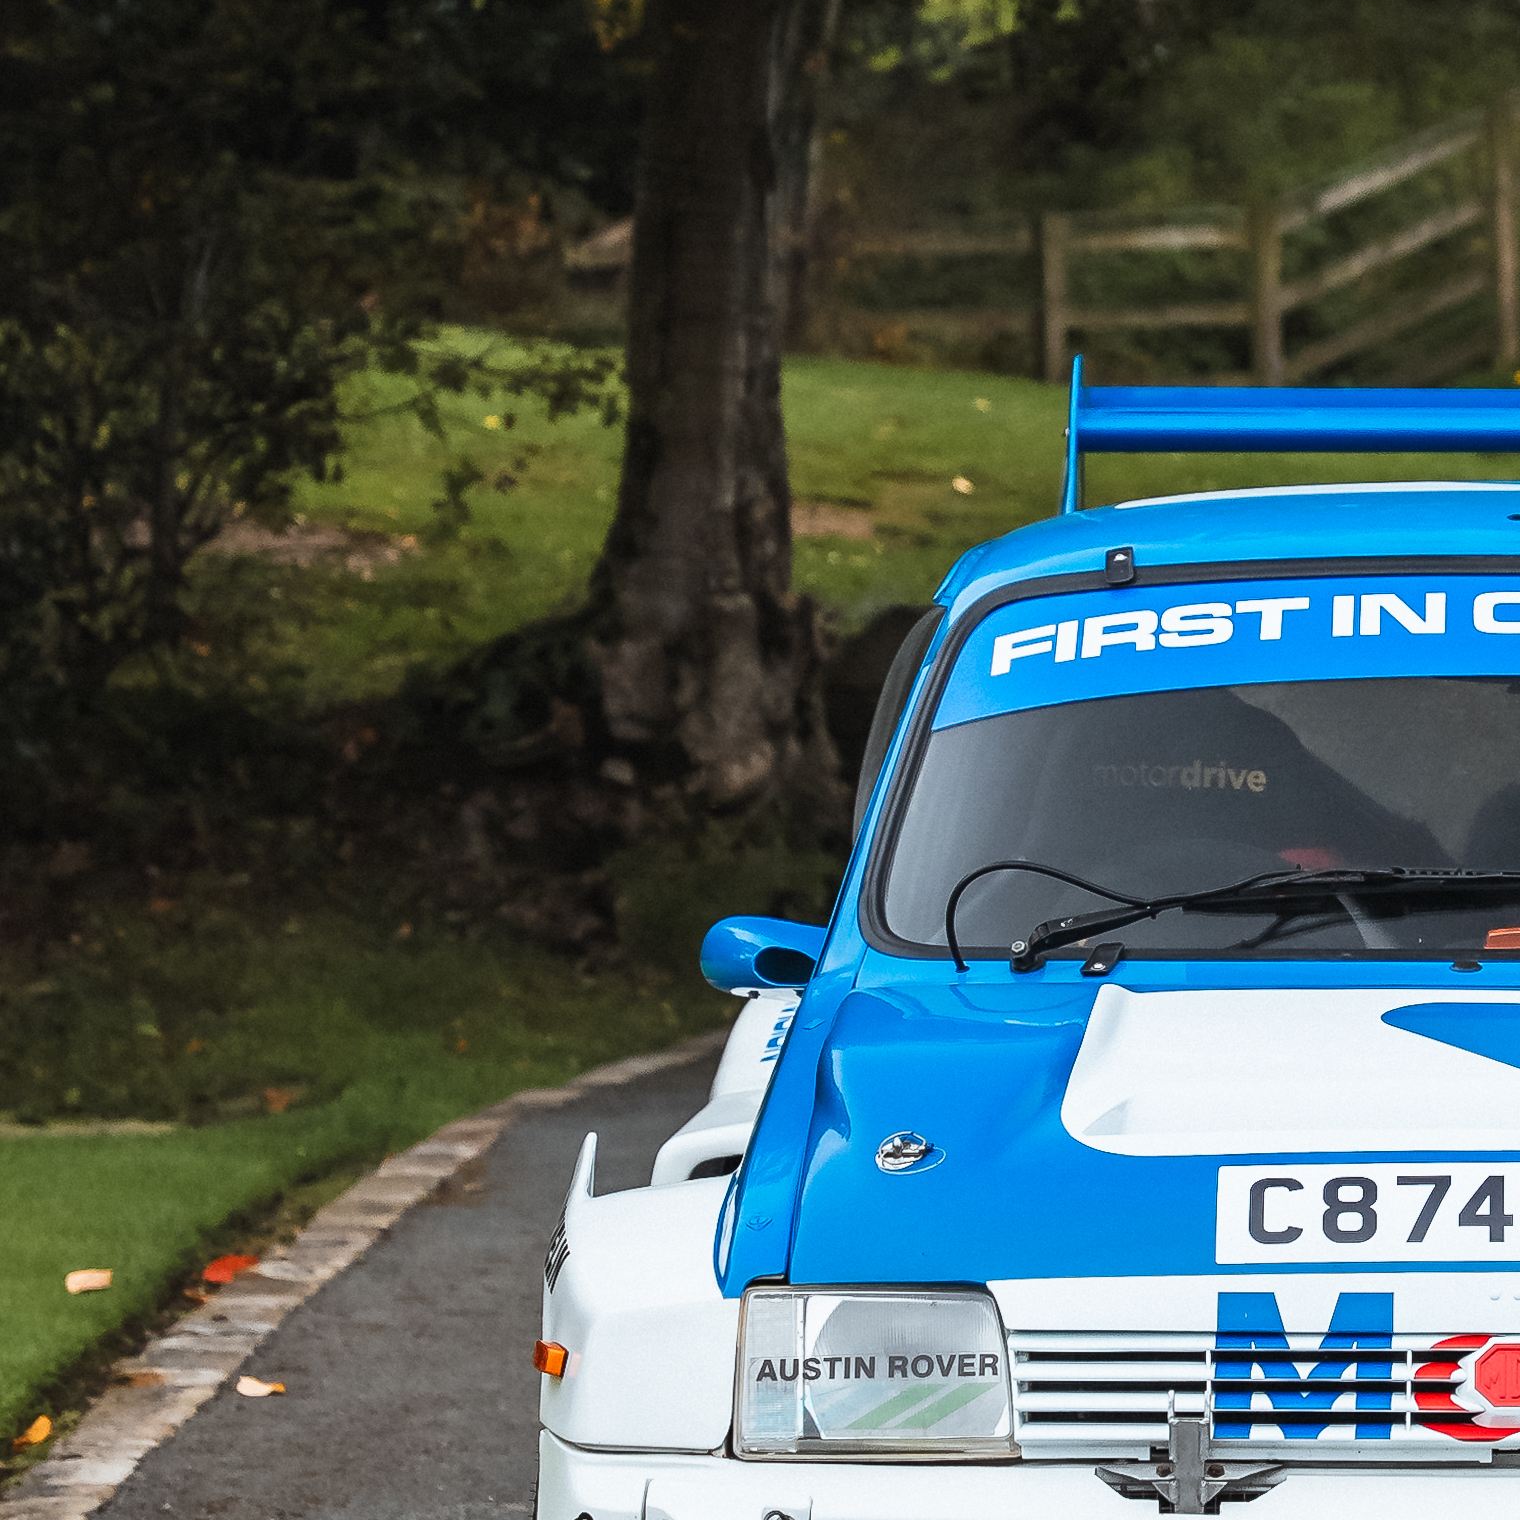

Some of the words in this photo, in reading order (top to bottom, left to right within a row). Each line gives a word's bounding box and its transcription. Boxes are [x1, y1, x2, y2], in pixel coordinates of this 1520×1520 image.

[990, 596, 1310, 677] FIRST
[1331, 591, 1447, 638] IN
[1248, 1174, 1514, 1245] C874
[755, 1356, 876, 1382] AUSTIN
[887, 1352, 1000, 1380] ROVER
